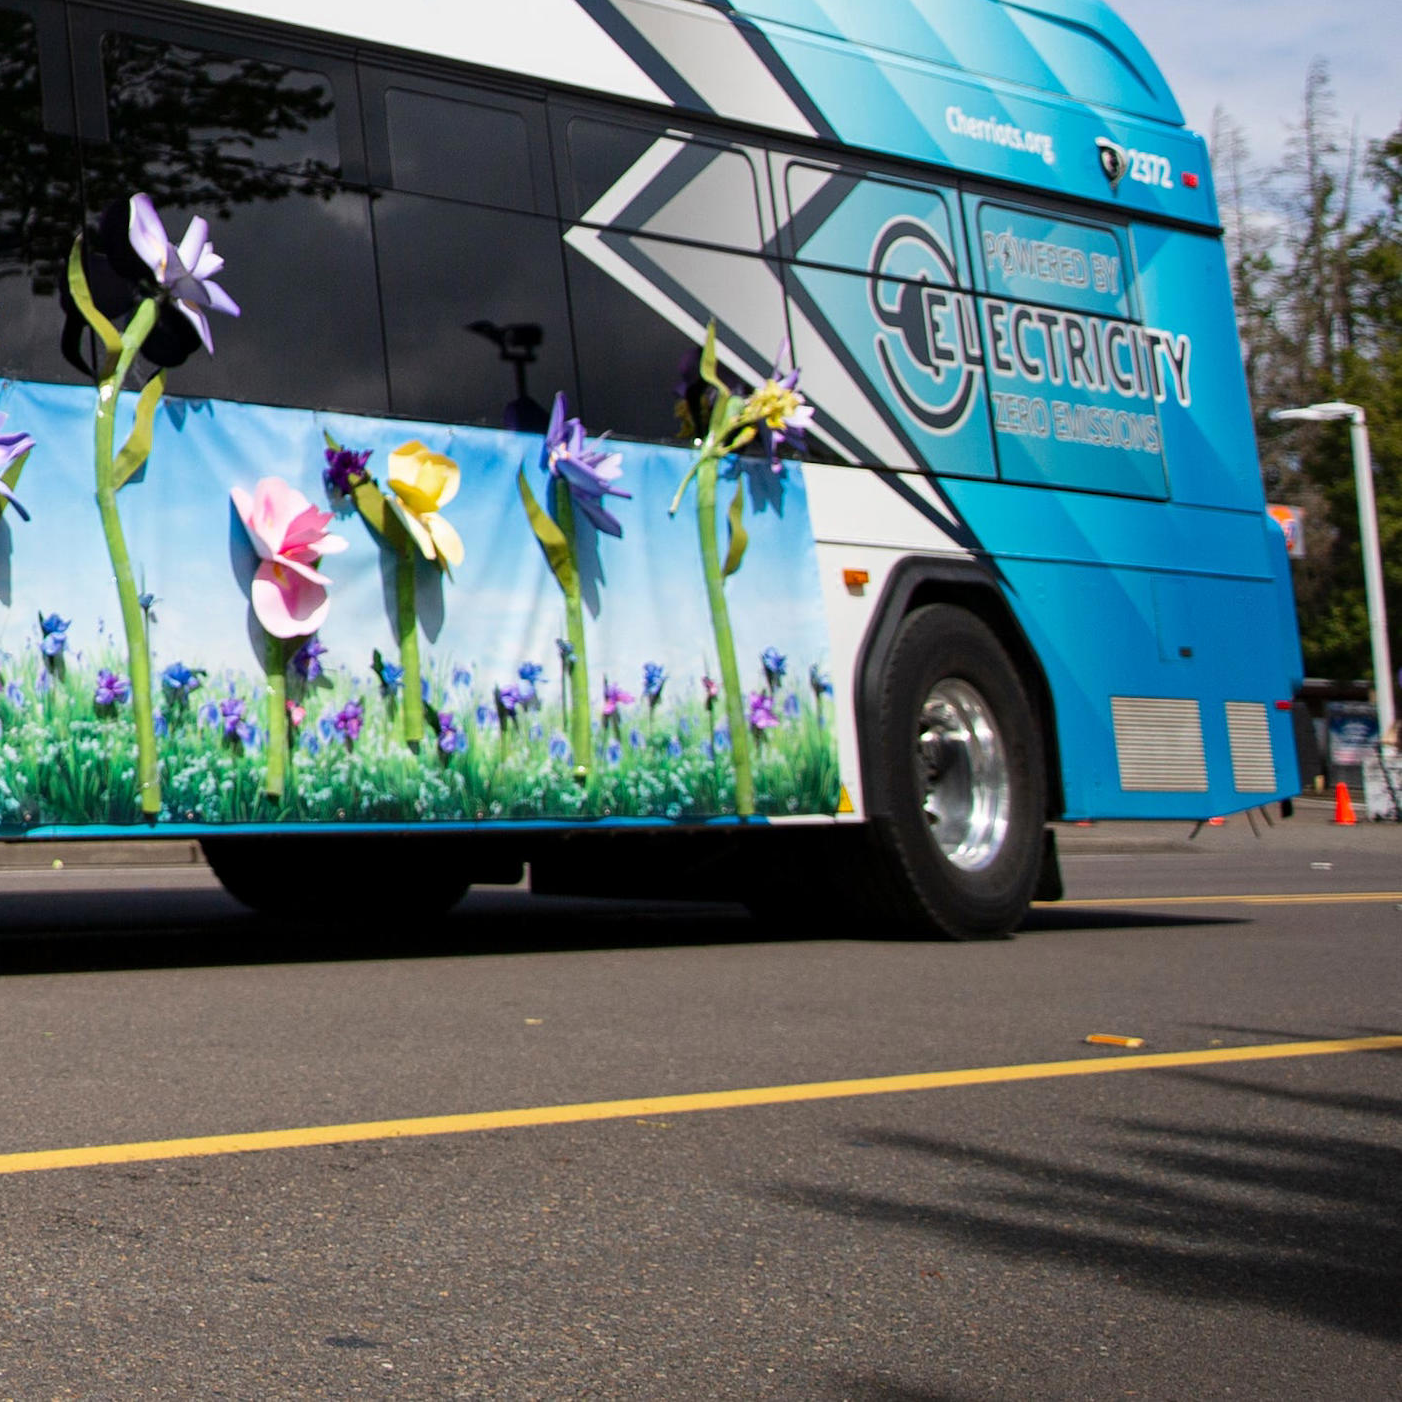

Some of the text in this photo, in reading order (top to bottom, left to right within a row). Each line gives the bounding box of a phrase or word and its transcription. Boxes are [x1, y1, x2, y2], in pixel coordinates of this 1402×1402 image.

[946, 106, 1054, 164] Cherriots.org
[1129, 150, 1173, 188] 2372
[983, 229, 1119, 295] POWERED BY
[924, 287, 1190, 407] ELECTRICITY
[992, 392, 1159, 453] ZERO EMISSIONS
